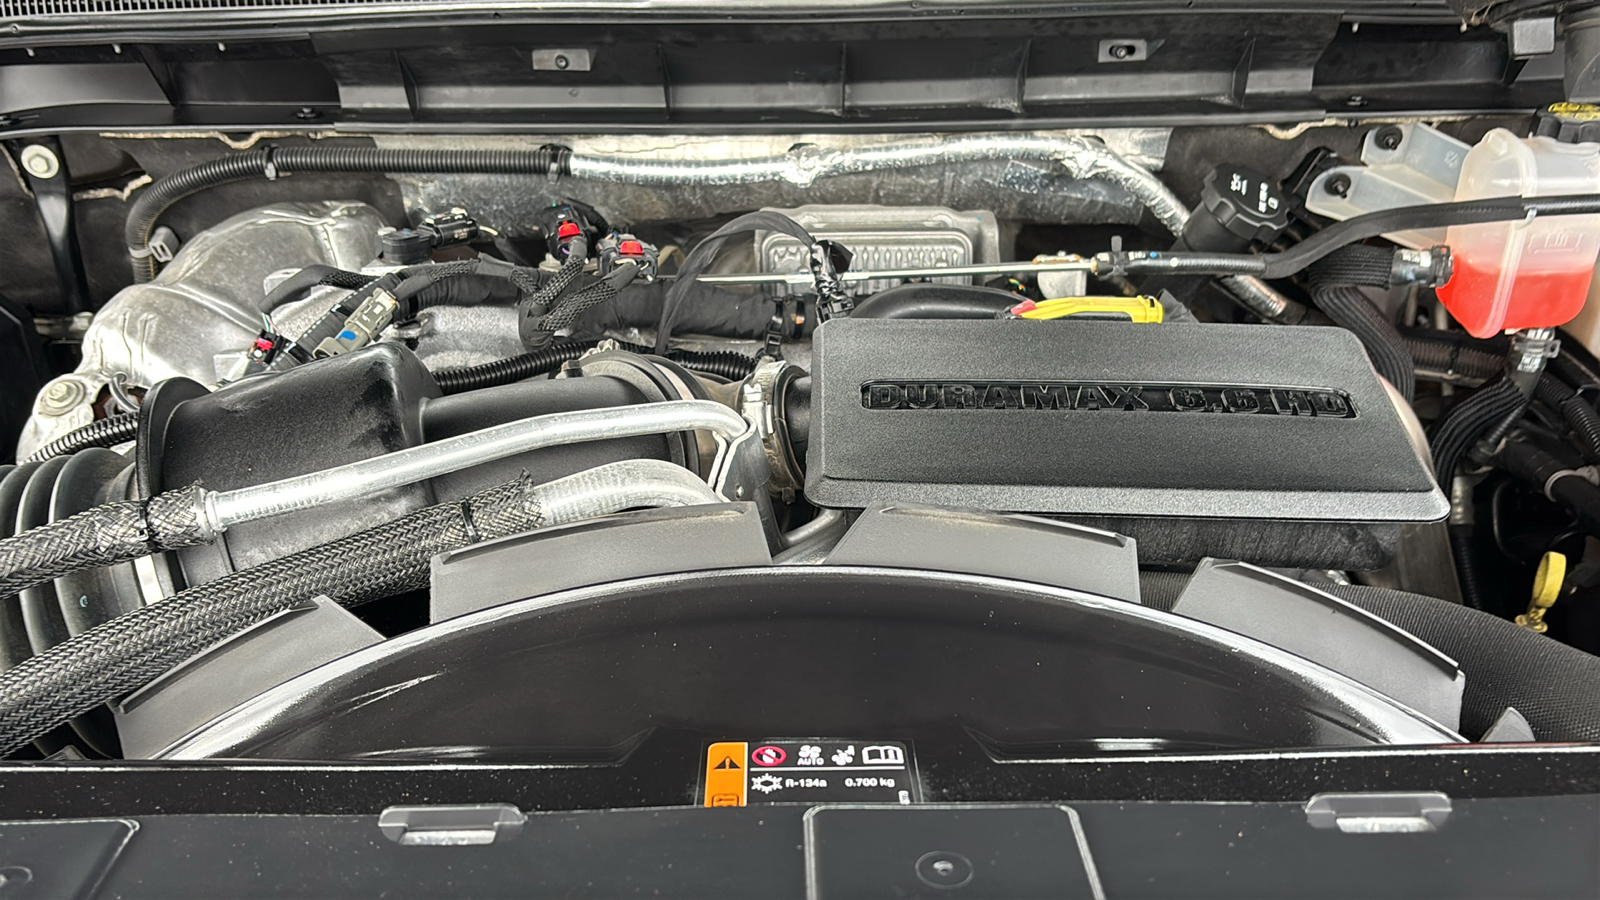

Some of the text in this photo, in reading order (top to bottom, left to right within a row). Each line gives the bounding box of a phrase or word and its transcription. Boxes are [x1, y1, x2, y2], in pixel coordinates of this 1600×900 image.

[869, 384, 1348, 417] DURAMAX 6.6 HD
[797, 757, 825, 766] AUTO
[785, 777, 896, 788] R-134a 0.700 kg
